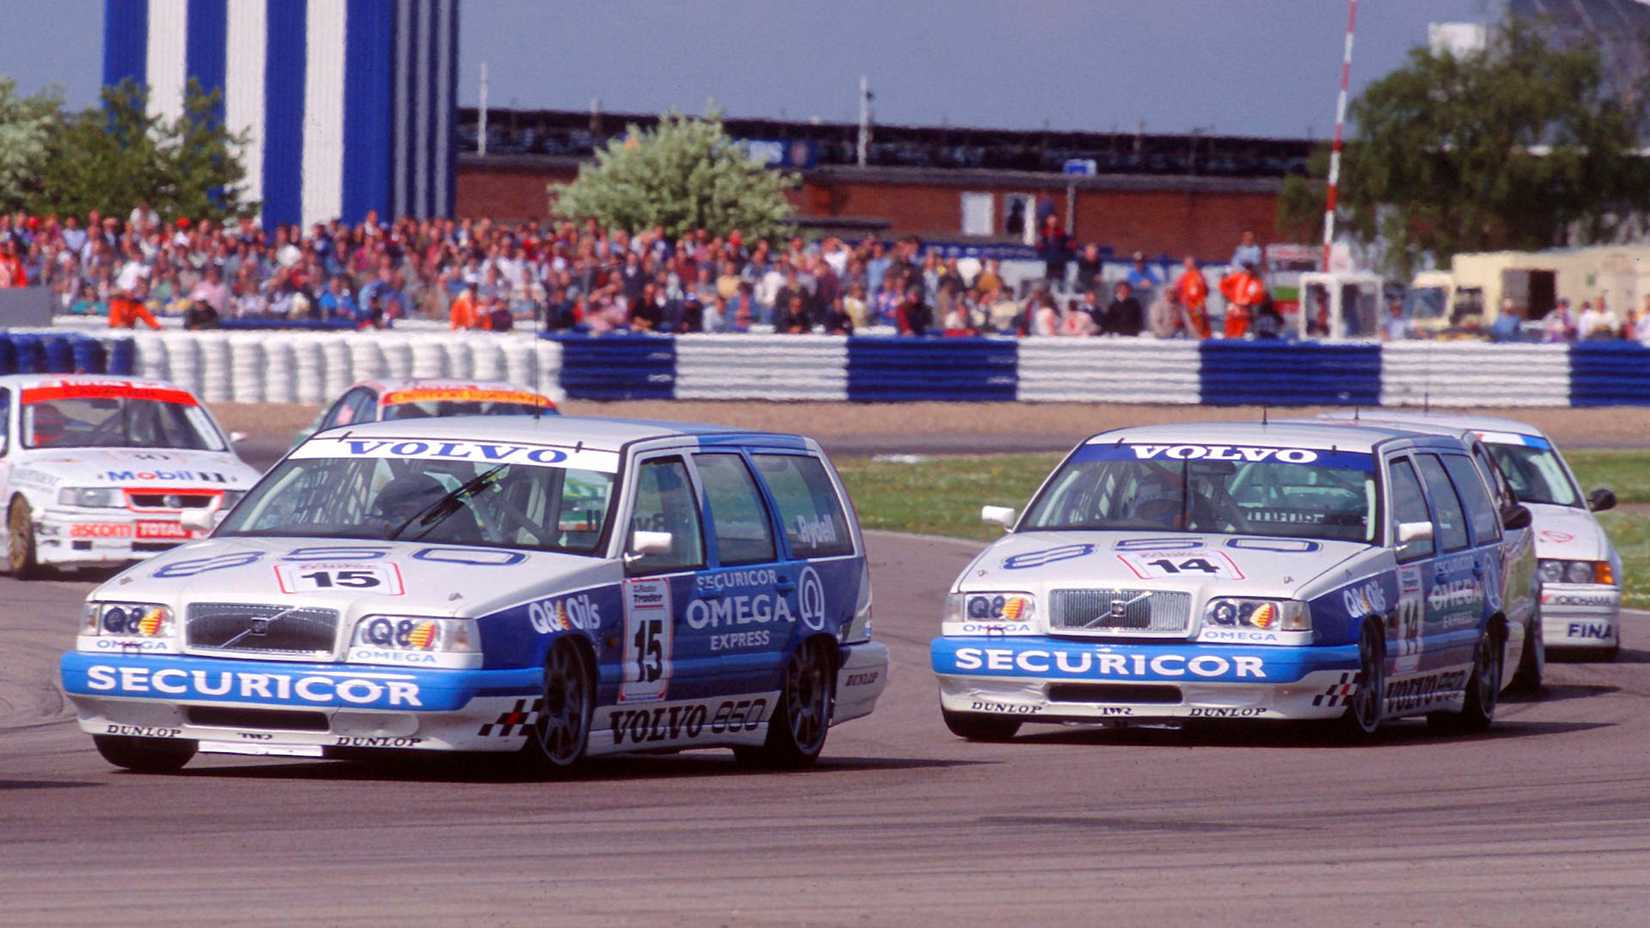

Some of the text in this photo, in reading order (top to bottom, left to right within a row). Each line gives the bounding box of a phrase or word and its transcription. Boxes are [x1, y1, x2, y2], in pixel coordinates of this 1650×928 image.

[346, 441, 567, 463] VOLVO
[1130, 445, 1318, 464] VOLVO
[106, 470, 194, 481] Mobil
[141, 522, 186, 536] TOTAL
[1147, 558, 1220, 573] 14
[301, 571, 381, 588] 15
[697, 569, 777, 592] SECURICOR
[529, 594, 600, 634] Q8 Oils
[686, 594, 796, 629] OMEGA
[967, 595, 1005, 619] Q8
[1212, 601, 1254, 626] Q8
[103, 606, 145, 634] Q8
[963, 624, 1030, 632] OMEGA
[368, 618, 414, 647] Q8
[710, 630, 770, 650] EXPRESS
[1203, 631, 1277, 641] OMEGA
[1567, 623, 1613, 639] FINA
[96, 639, 168, 649] OMEGA
[634, 619, 662, 684] 15
[355, 652, 437, 663] OMEGA
[955, 648, 1266, 677] SECURICOR
[87, 665, 422, 706] SECURICOR
[971, 702, 1042, 714] DUNLOP
[1190, 707, 1267, 717] DUNLOP
[107, 725, 181, 738] DUNLOP
[609, 704, 708, 745] VOLVO
[337, 737, 422, 747] DUNLOP
